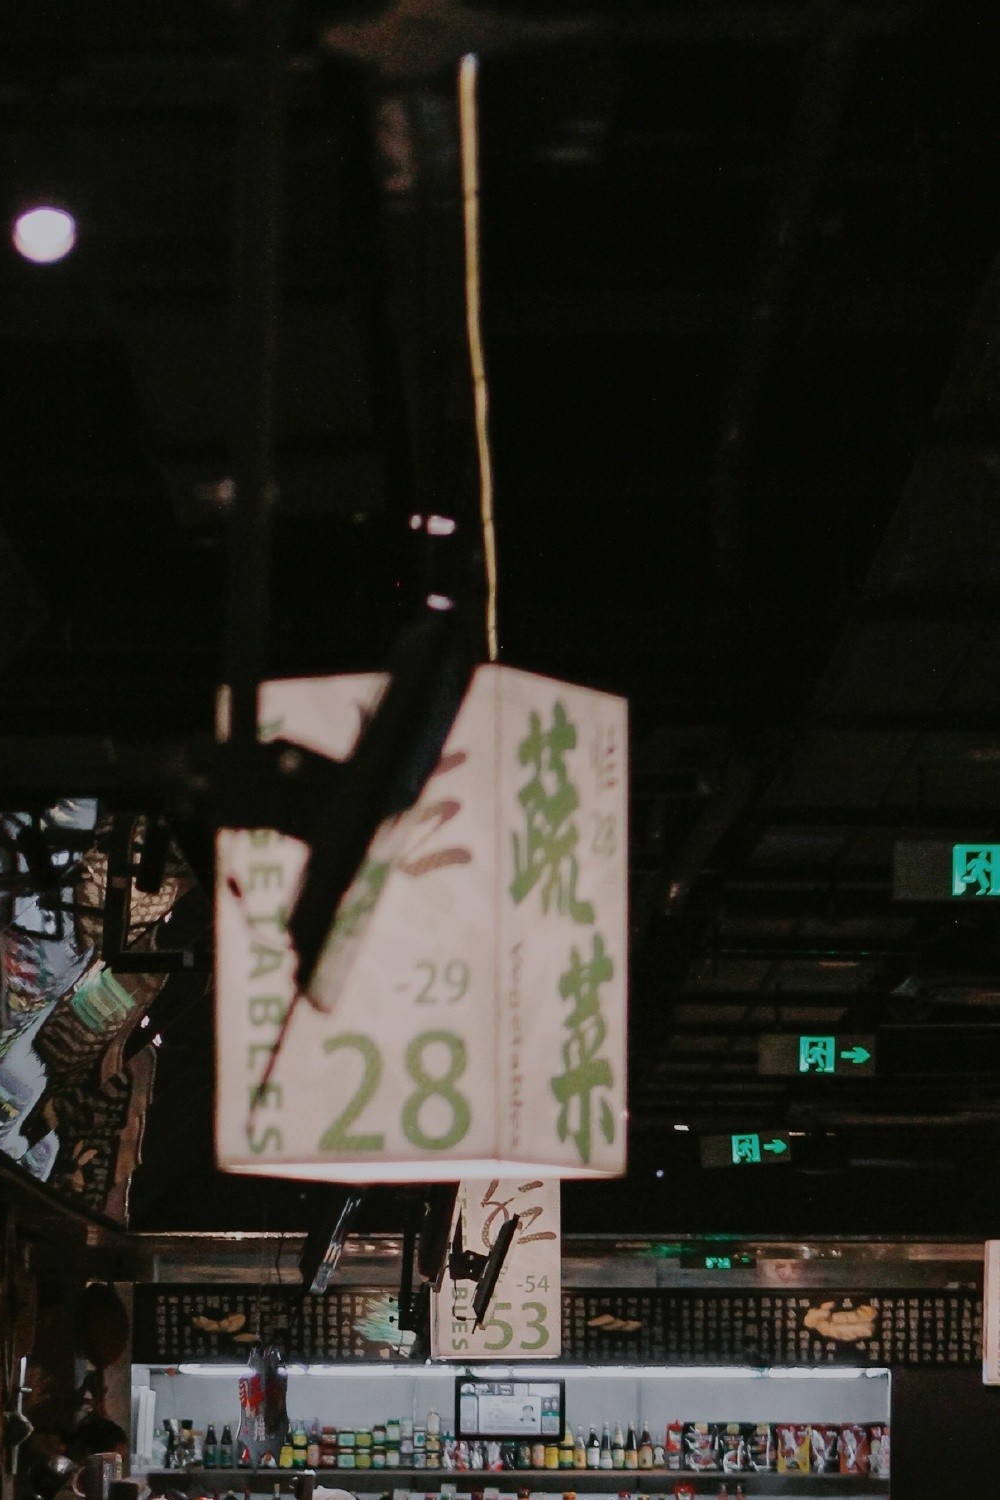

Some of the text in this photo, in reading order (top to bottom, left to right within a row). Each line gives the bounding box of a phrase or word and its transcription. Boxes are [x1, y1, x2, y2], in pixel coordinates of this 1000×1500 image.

[509, 699, 615, 1165] 蔬菜
[244, 829, 287, 1155] ETABLES
[395, 957, 471, 1009] -29
[318, 1028, 472, 1153] 28
[482, 1302, 550, 1351] 53
[516, 1275, 550, 1293] -54
